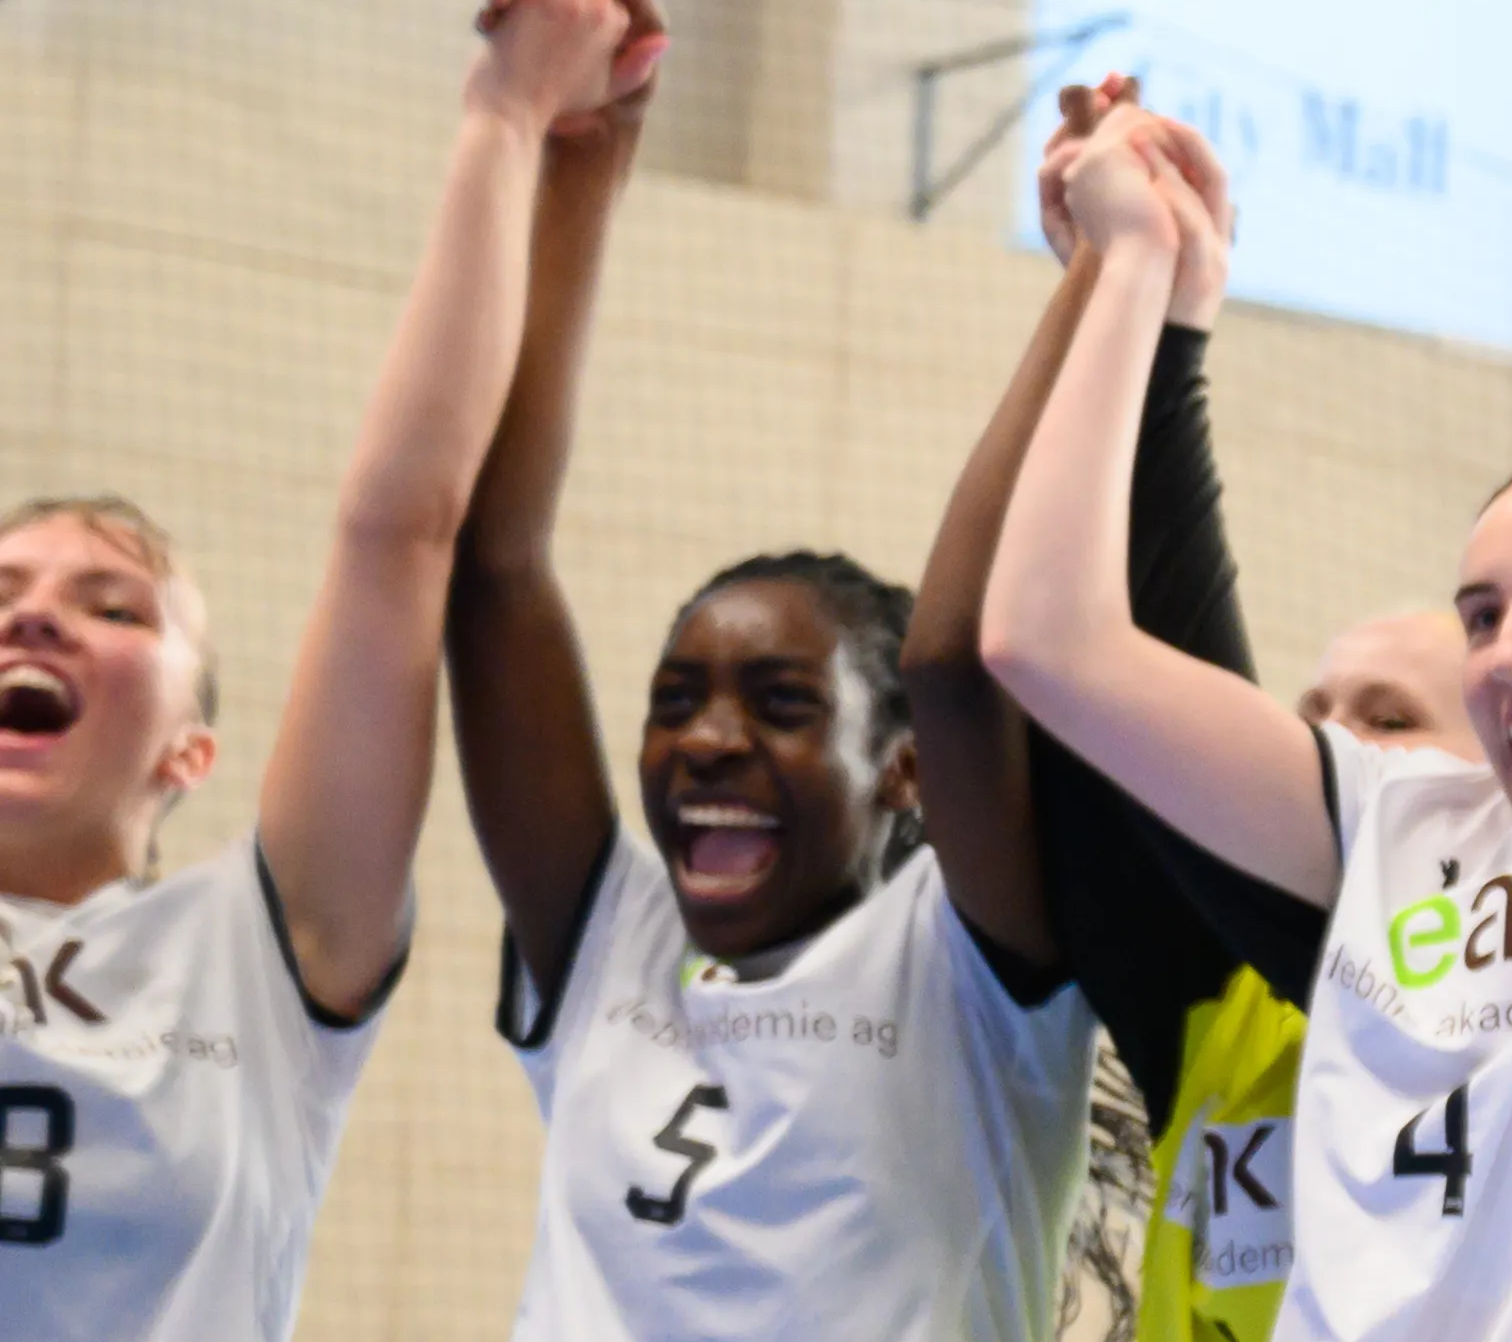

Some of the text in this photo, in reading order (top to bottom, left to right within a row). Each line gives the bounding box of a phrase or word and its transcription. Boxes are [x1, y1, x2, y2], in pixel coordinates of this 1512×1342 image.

[1300, 89, 1450, 199] Mall
[852, 1013, 900, 1059] ag
[624, 1082, 730, 1227] 5
[1393, 1083, 1473, 1218] 4
